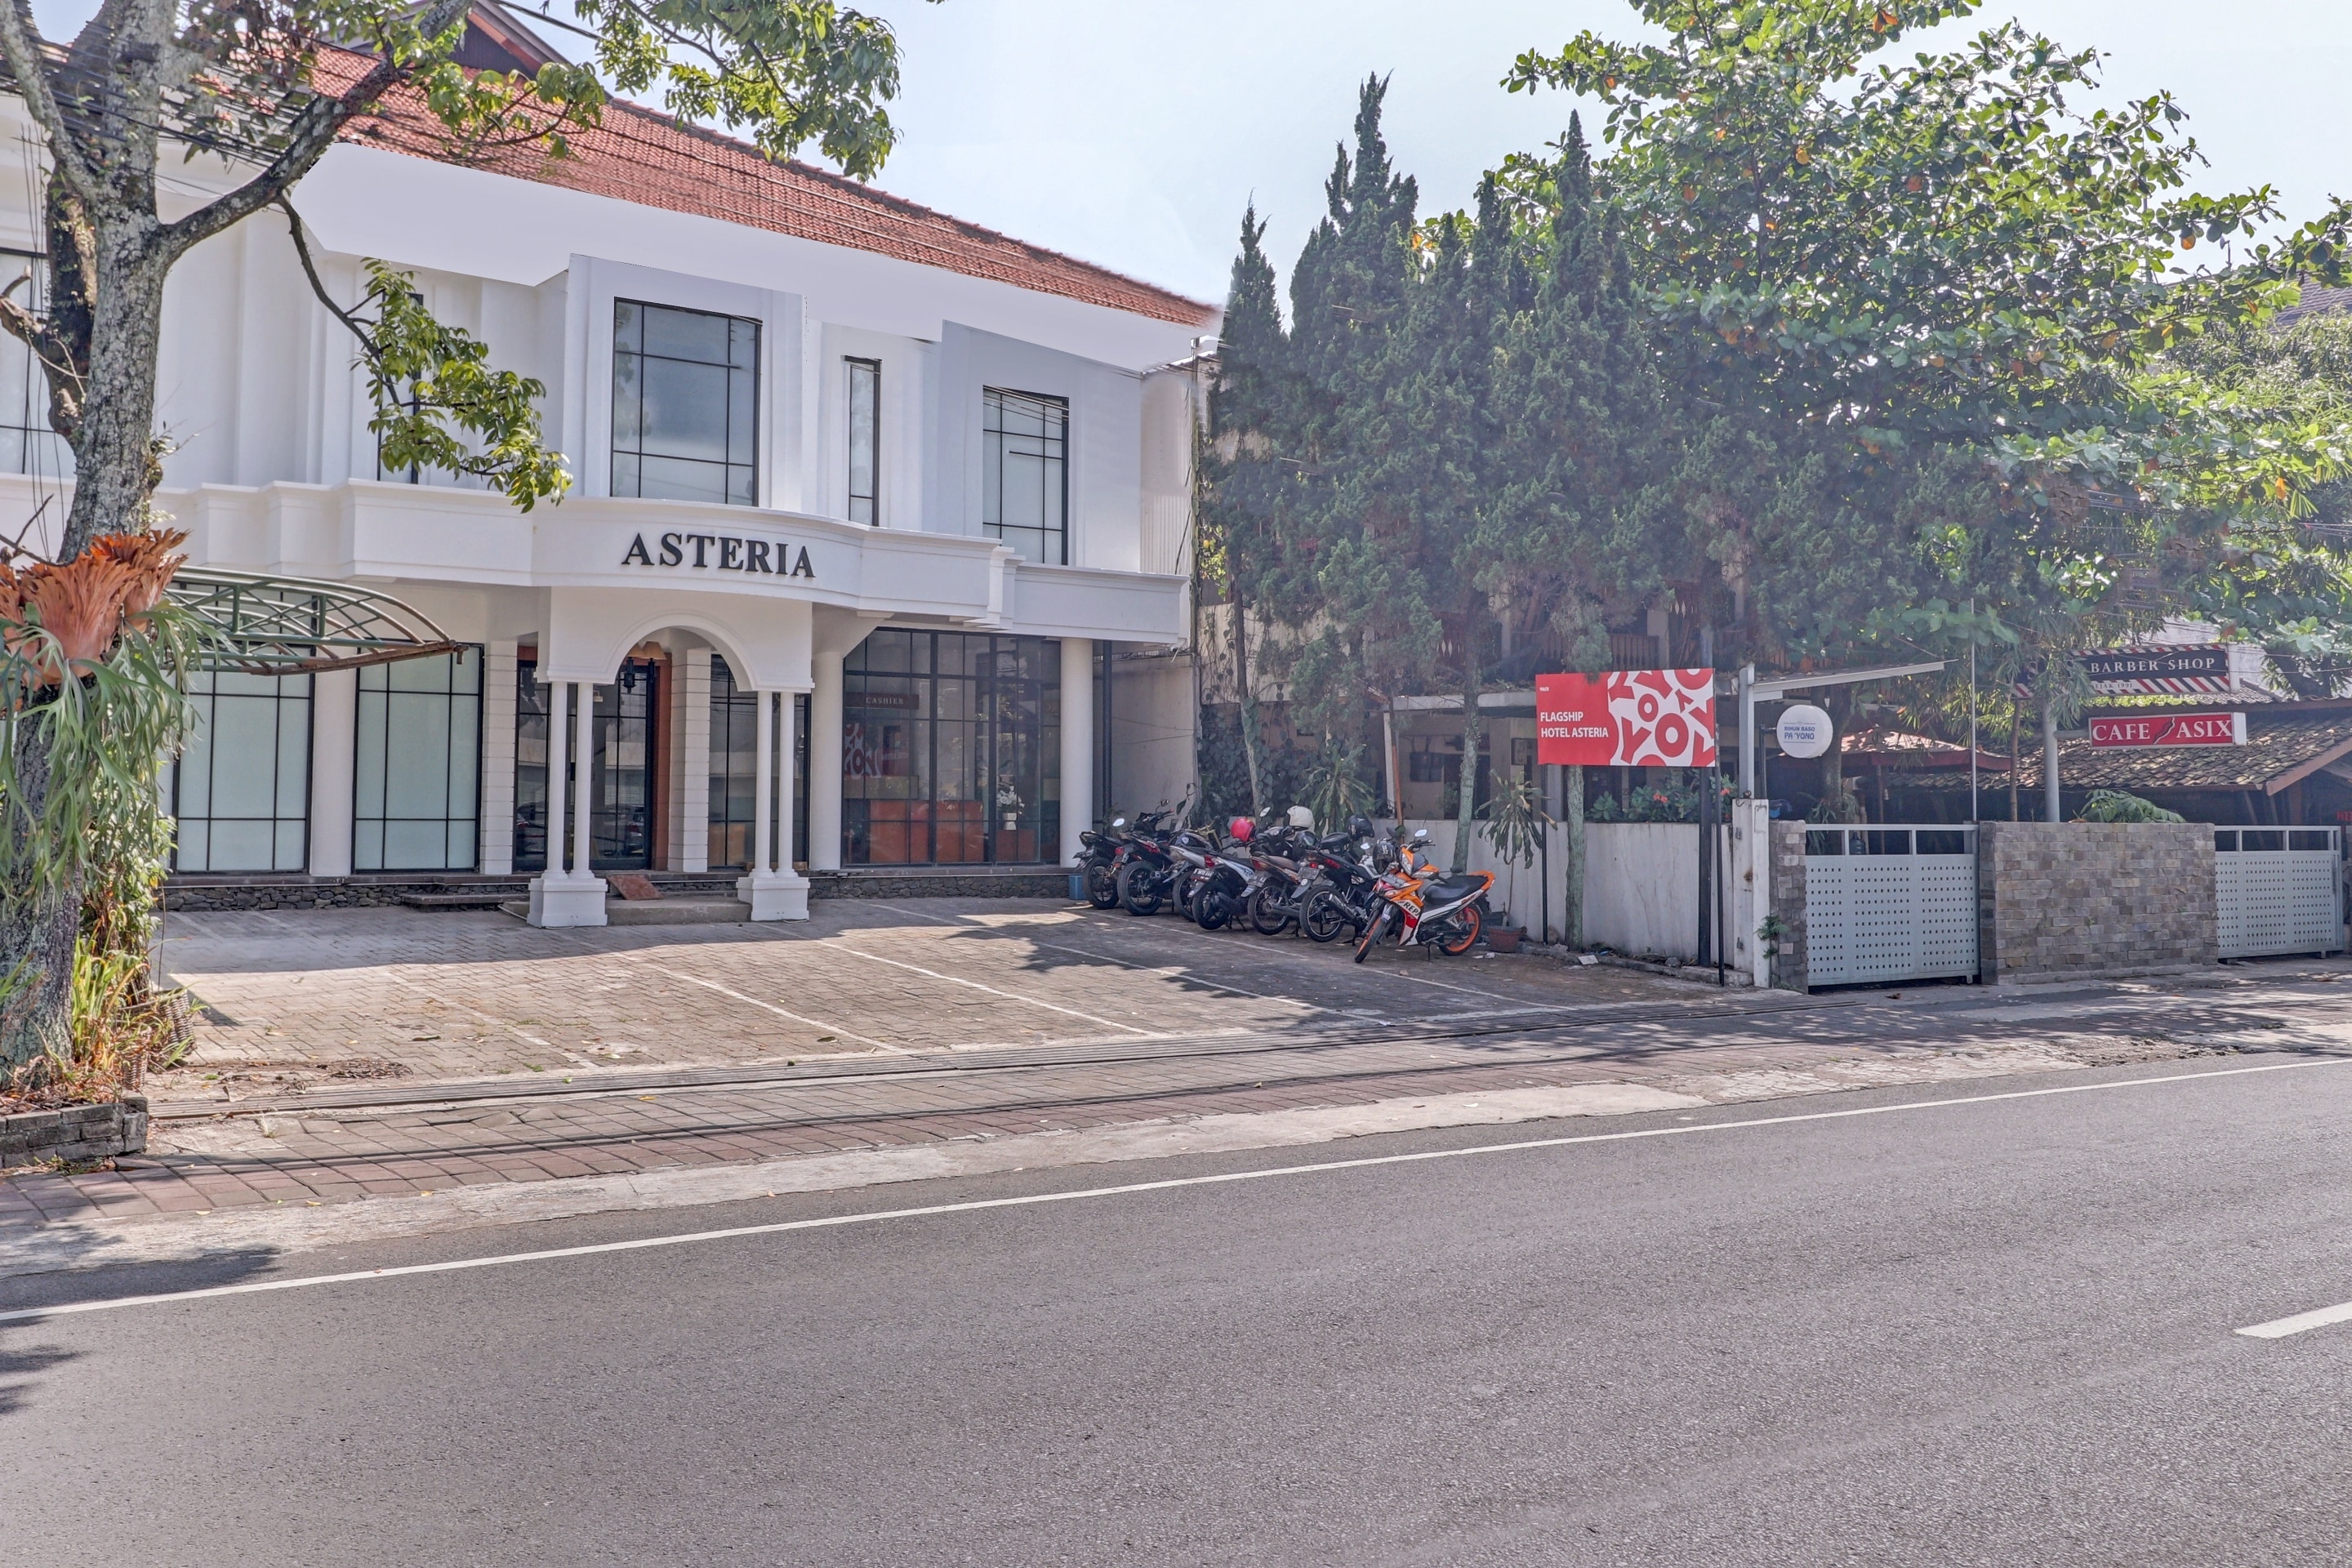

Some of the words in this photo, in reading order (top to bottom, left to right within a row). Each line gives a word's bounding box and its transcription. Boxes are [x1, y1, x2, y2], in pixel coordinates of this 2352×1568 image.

[621, 532, 816, 578] ASTERIA
[2091, 660, 2159, 673] BARBER
[2167, 657, 2216, 670] SHOP
[866, 697, 904, 705] CASHIER
[1539, 711, 1584, 723] FLAGSHIP
[1540, 727, 1570, 738] HOTEL
[1570, 727, 1609, 738] ASTERIA
[2092, 723, 2150, 742] CAFE
[2176, 720, 2233, 739] ASIX
